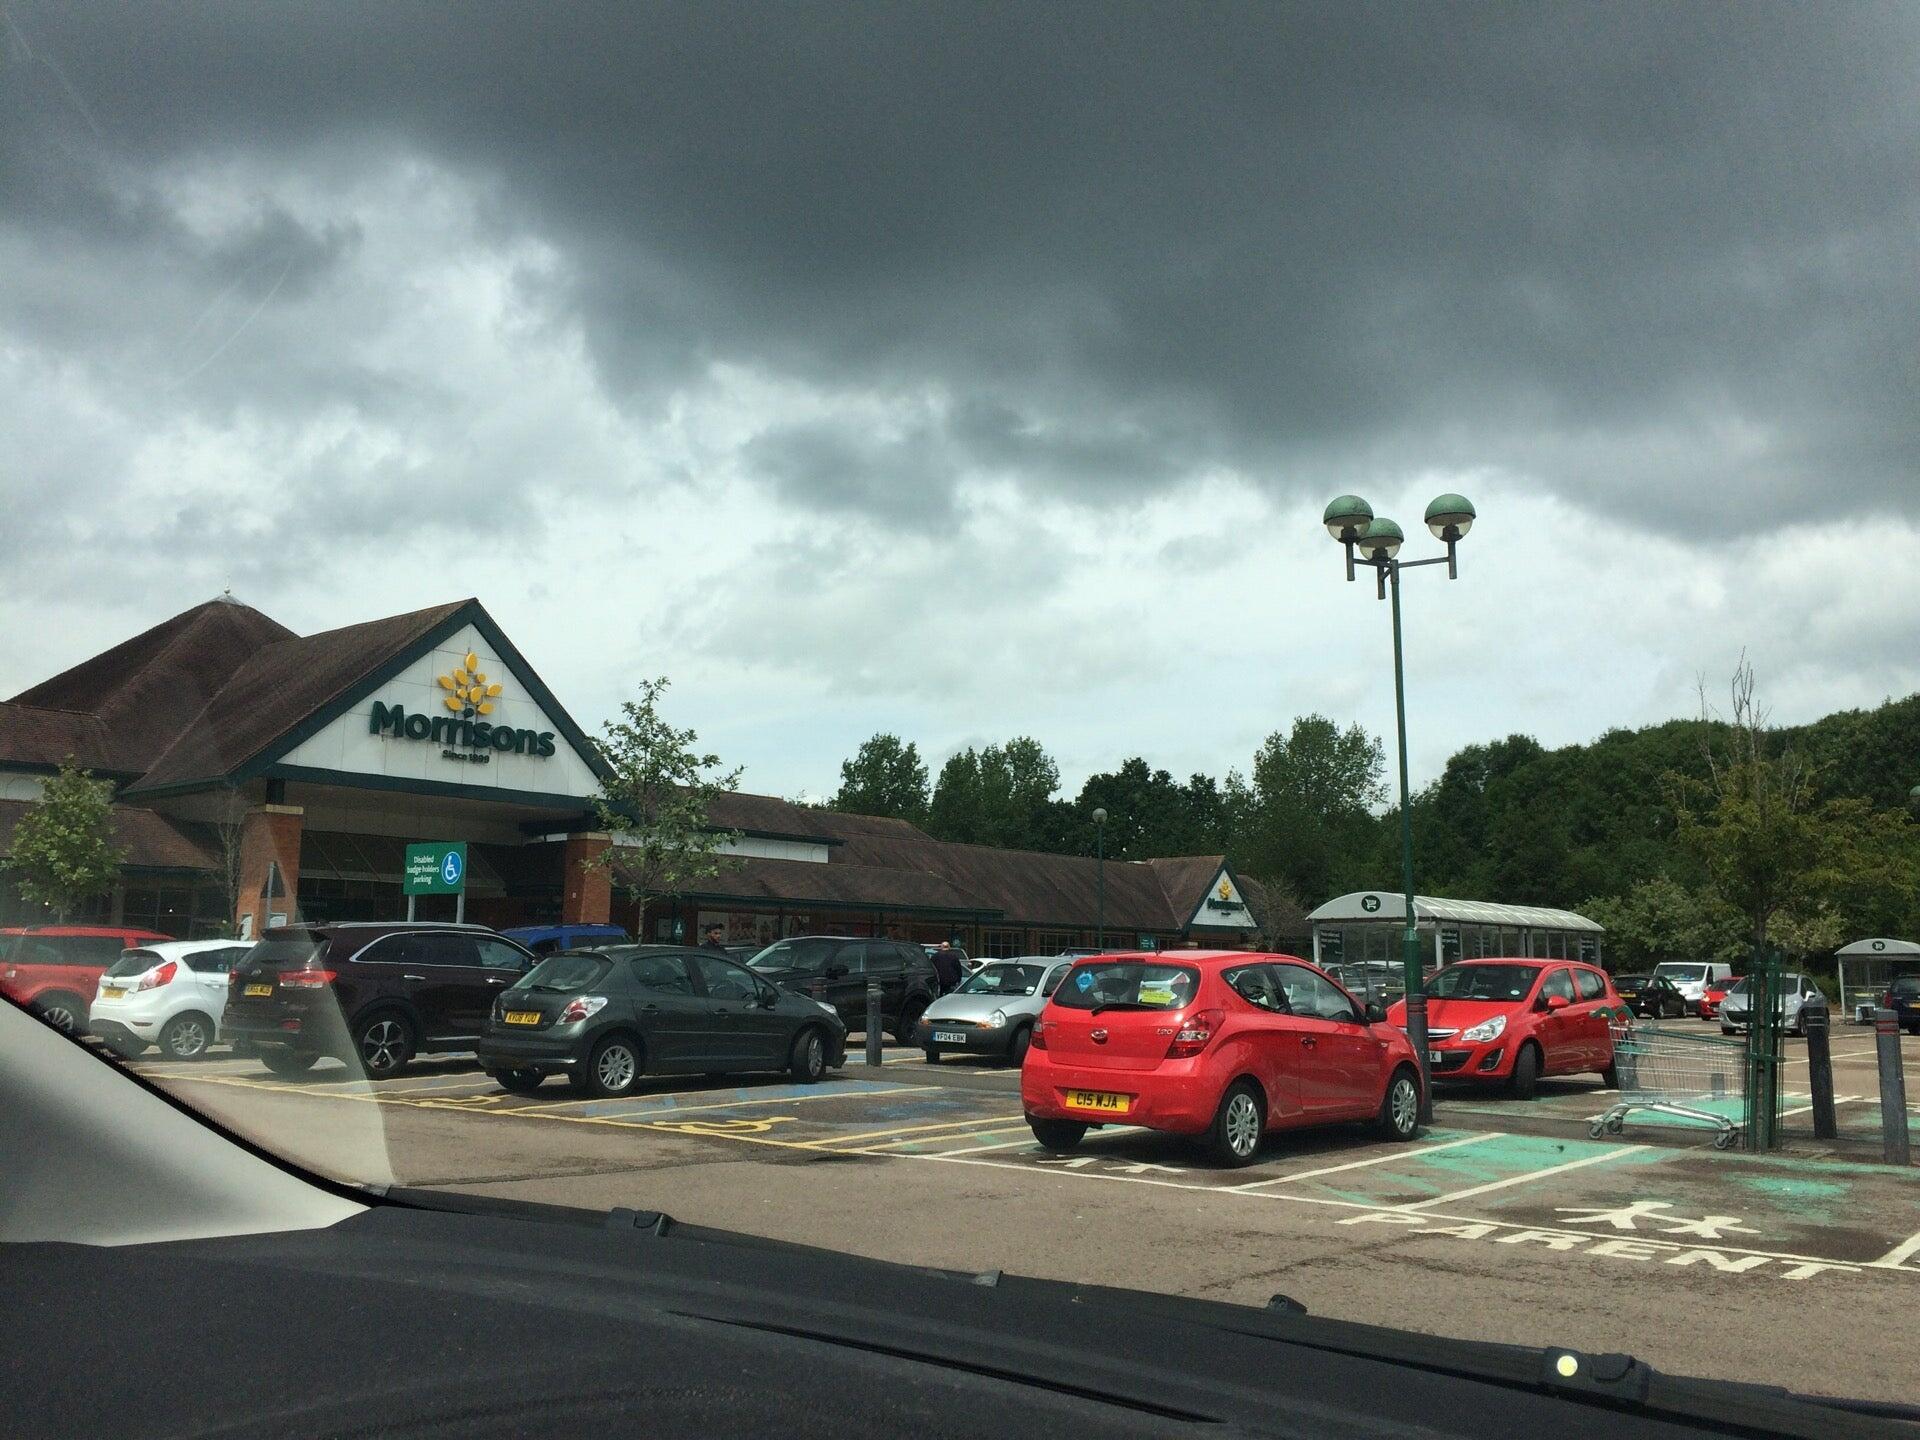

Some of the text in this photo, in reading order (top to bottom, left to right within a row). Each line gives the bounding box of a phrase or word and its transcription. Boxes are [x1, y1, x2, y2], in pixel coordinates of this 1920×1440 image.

[370, 700, 556, 757] Morrisons
[442, 749, 467, 760] Since
[413, 855, 435, 863] Disabled
[406, 865, 440, 875] badge holders
[413, 875, 432, 885] parking
[1076, 1092, 1118, 1108] C15 WJA
[1334, 1213, 1862, 1281] PARENT
